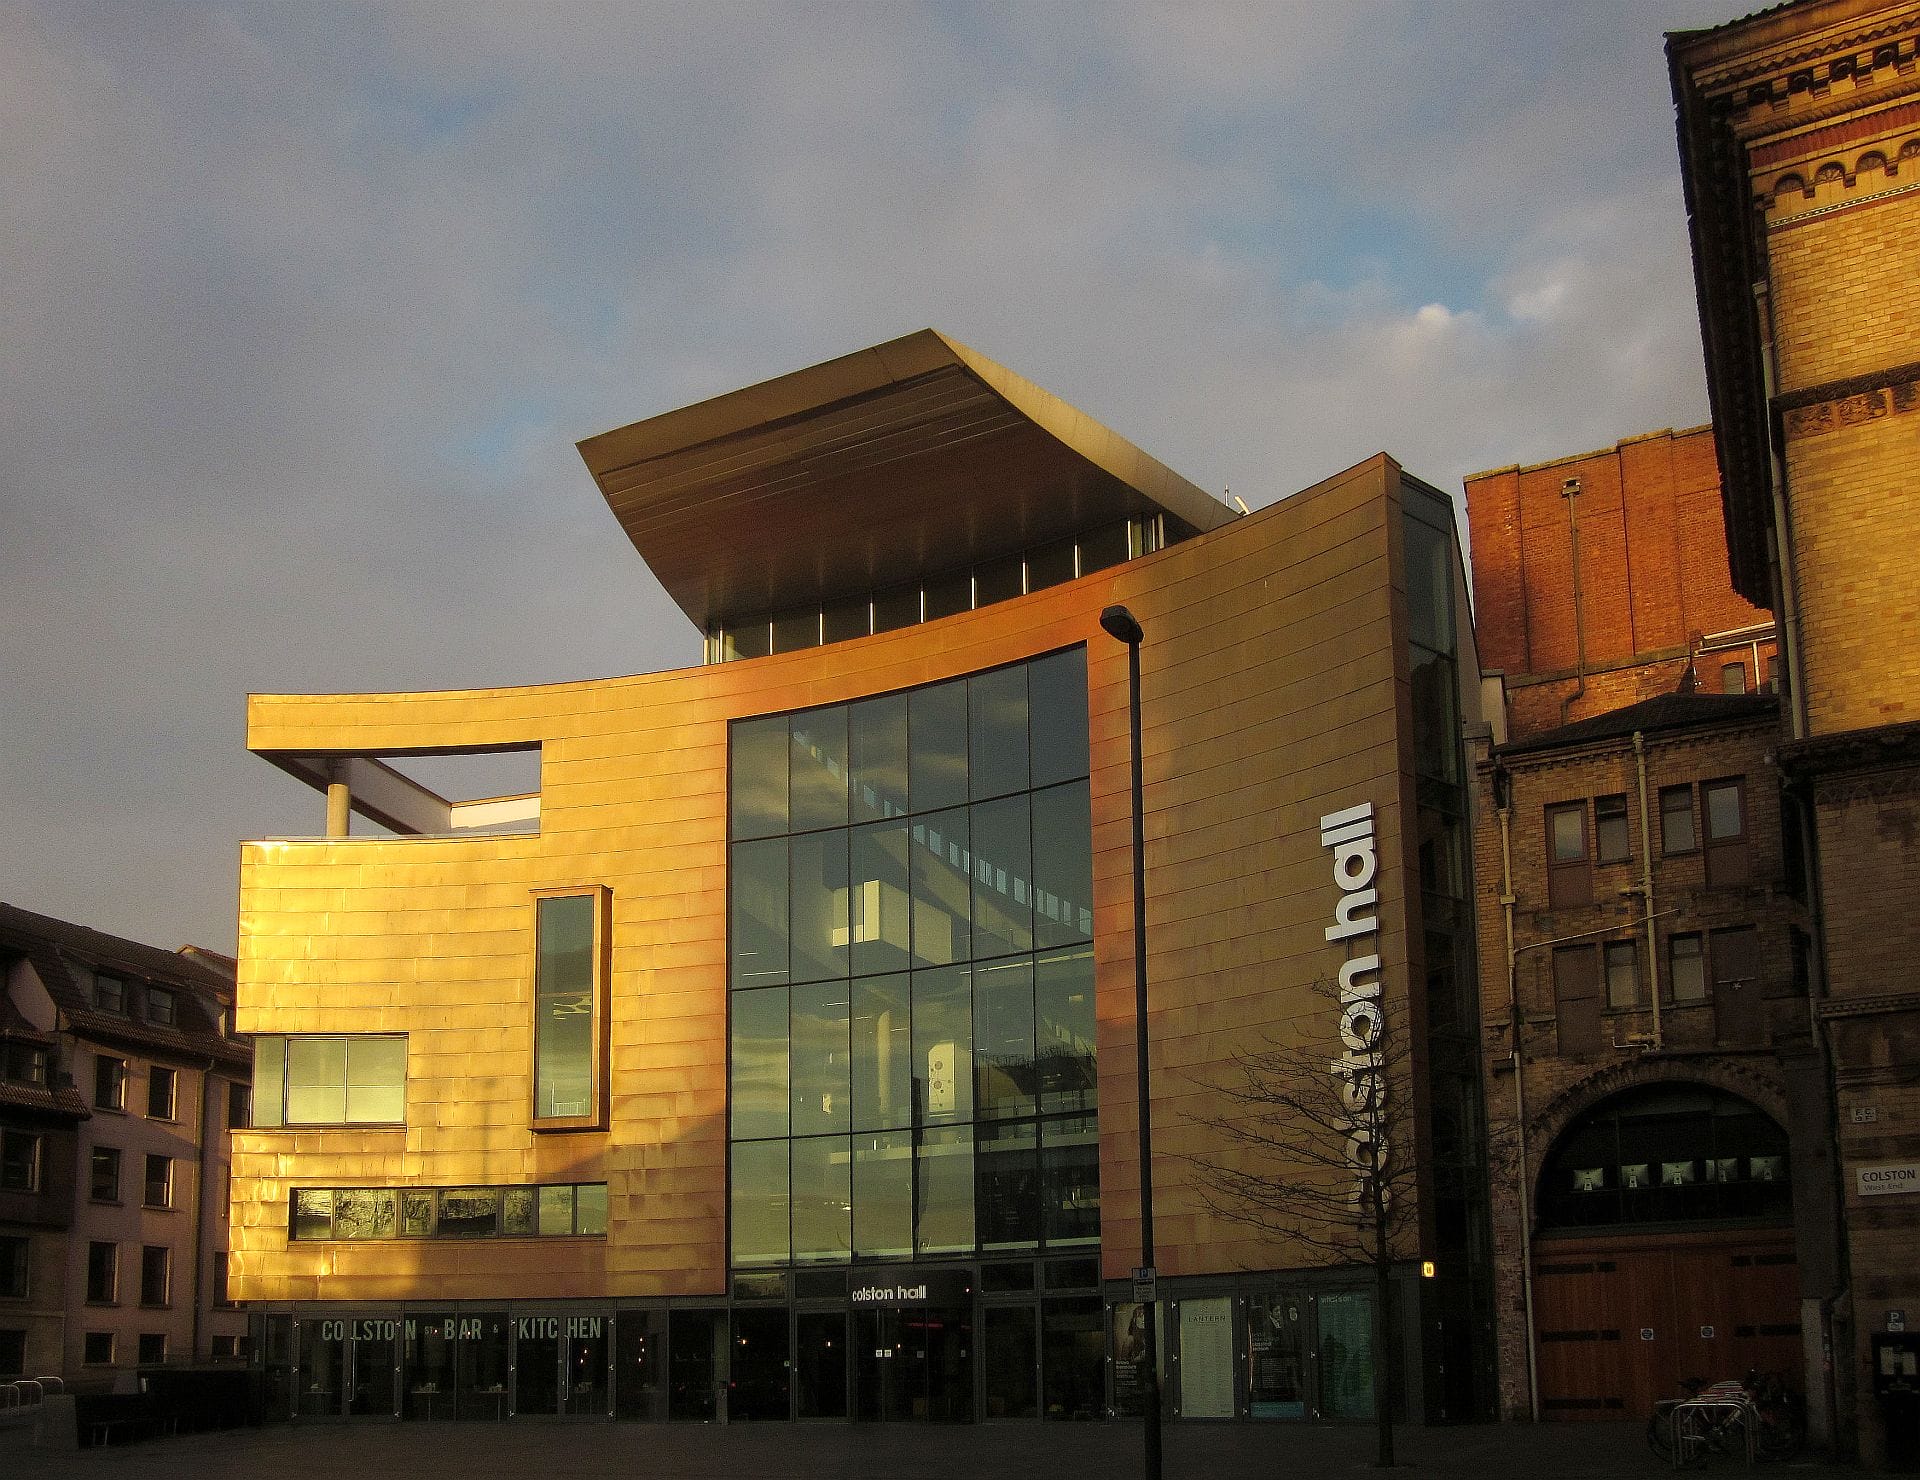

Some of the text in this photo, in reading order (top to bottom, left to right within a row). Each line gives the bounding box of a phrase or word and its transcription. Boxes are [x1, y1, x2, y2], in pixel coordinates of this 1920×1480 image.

[1320, 802, 1390, 1220] colston hall
[1862, 1169, 1916, 1182] COLSTON
[852, 1285, 926, 1301] colston hall
[1188, 1315, 1226, 1323] LANTERN
[1890, 1312, 1900, 1323] P
[444, 1318, 482, 1340] BAR
[492, 1323, 499, 1334] &
[518, 1316, 601, 1339] KITCHEN
